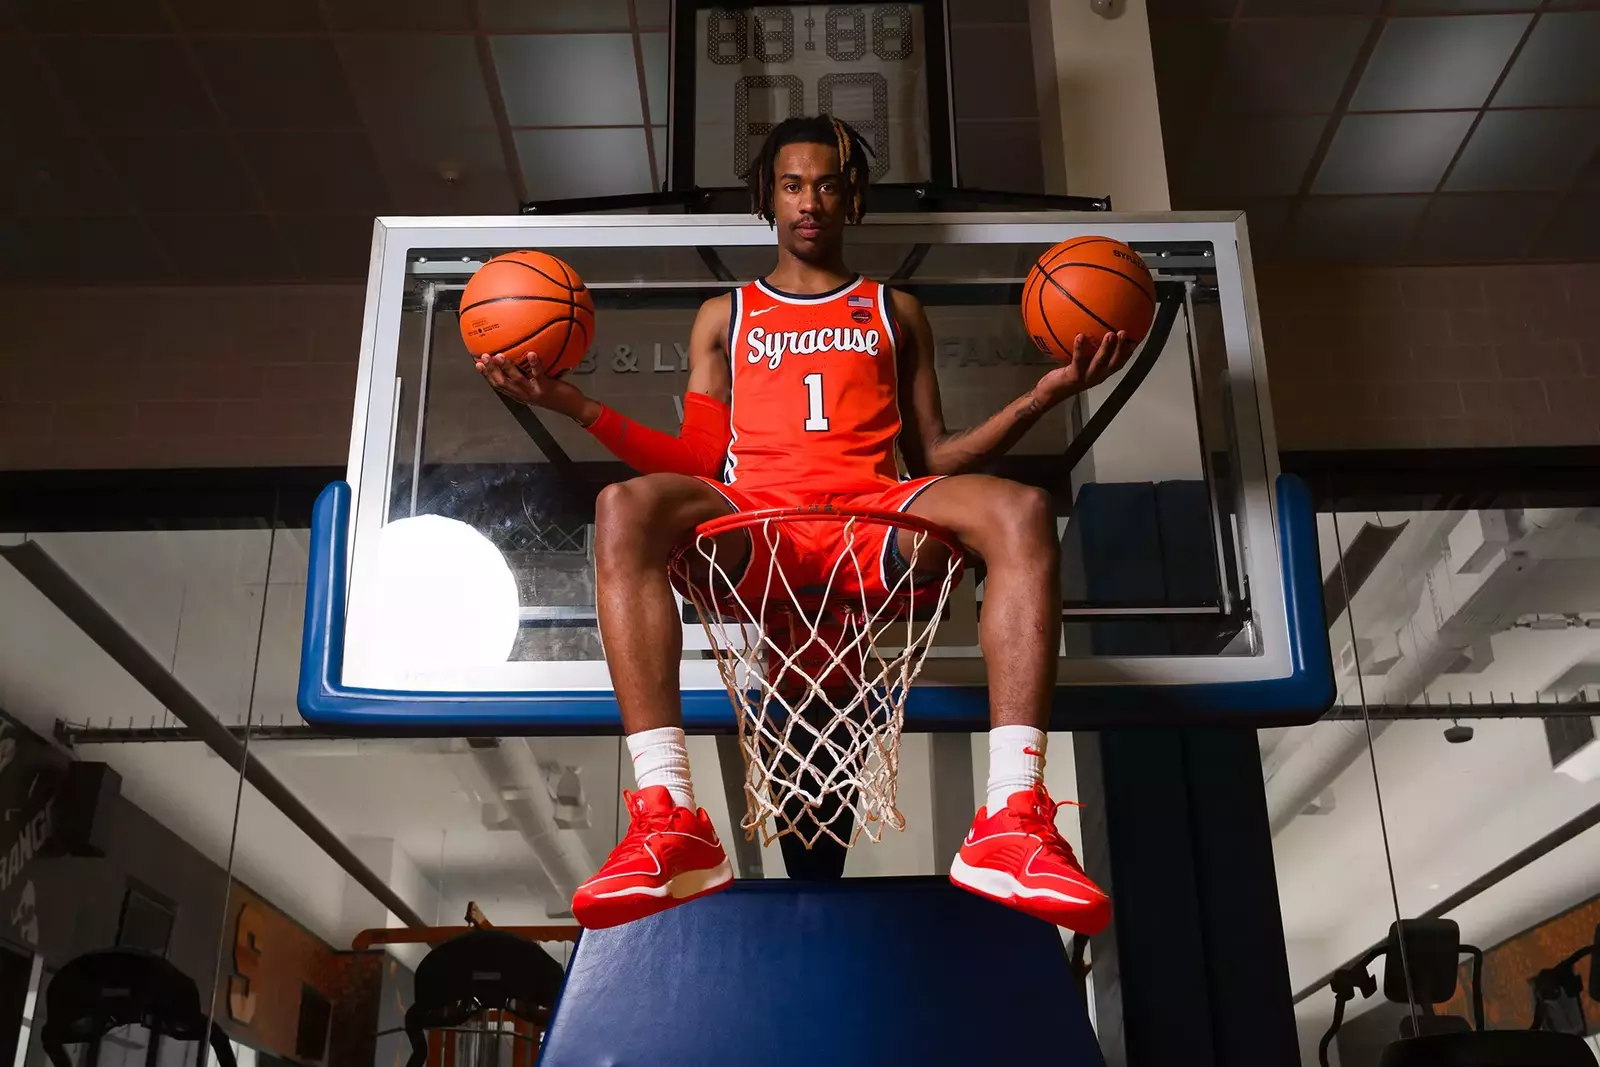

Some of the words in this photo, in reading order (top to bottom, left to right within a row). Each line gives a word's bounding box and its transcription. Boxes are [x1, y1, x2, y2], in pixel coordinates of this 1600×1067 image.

[611, 344, 640, 373] &
[747, 327, 880, 370] Syracuse
[803, 373, 829, 432] 1
